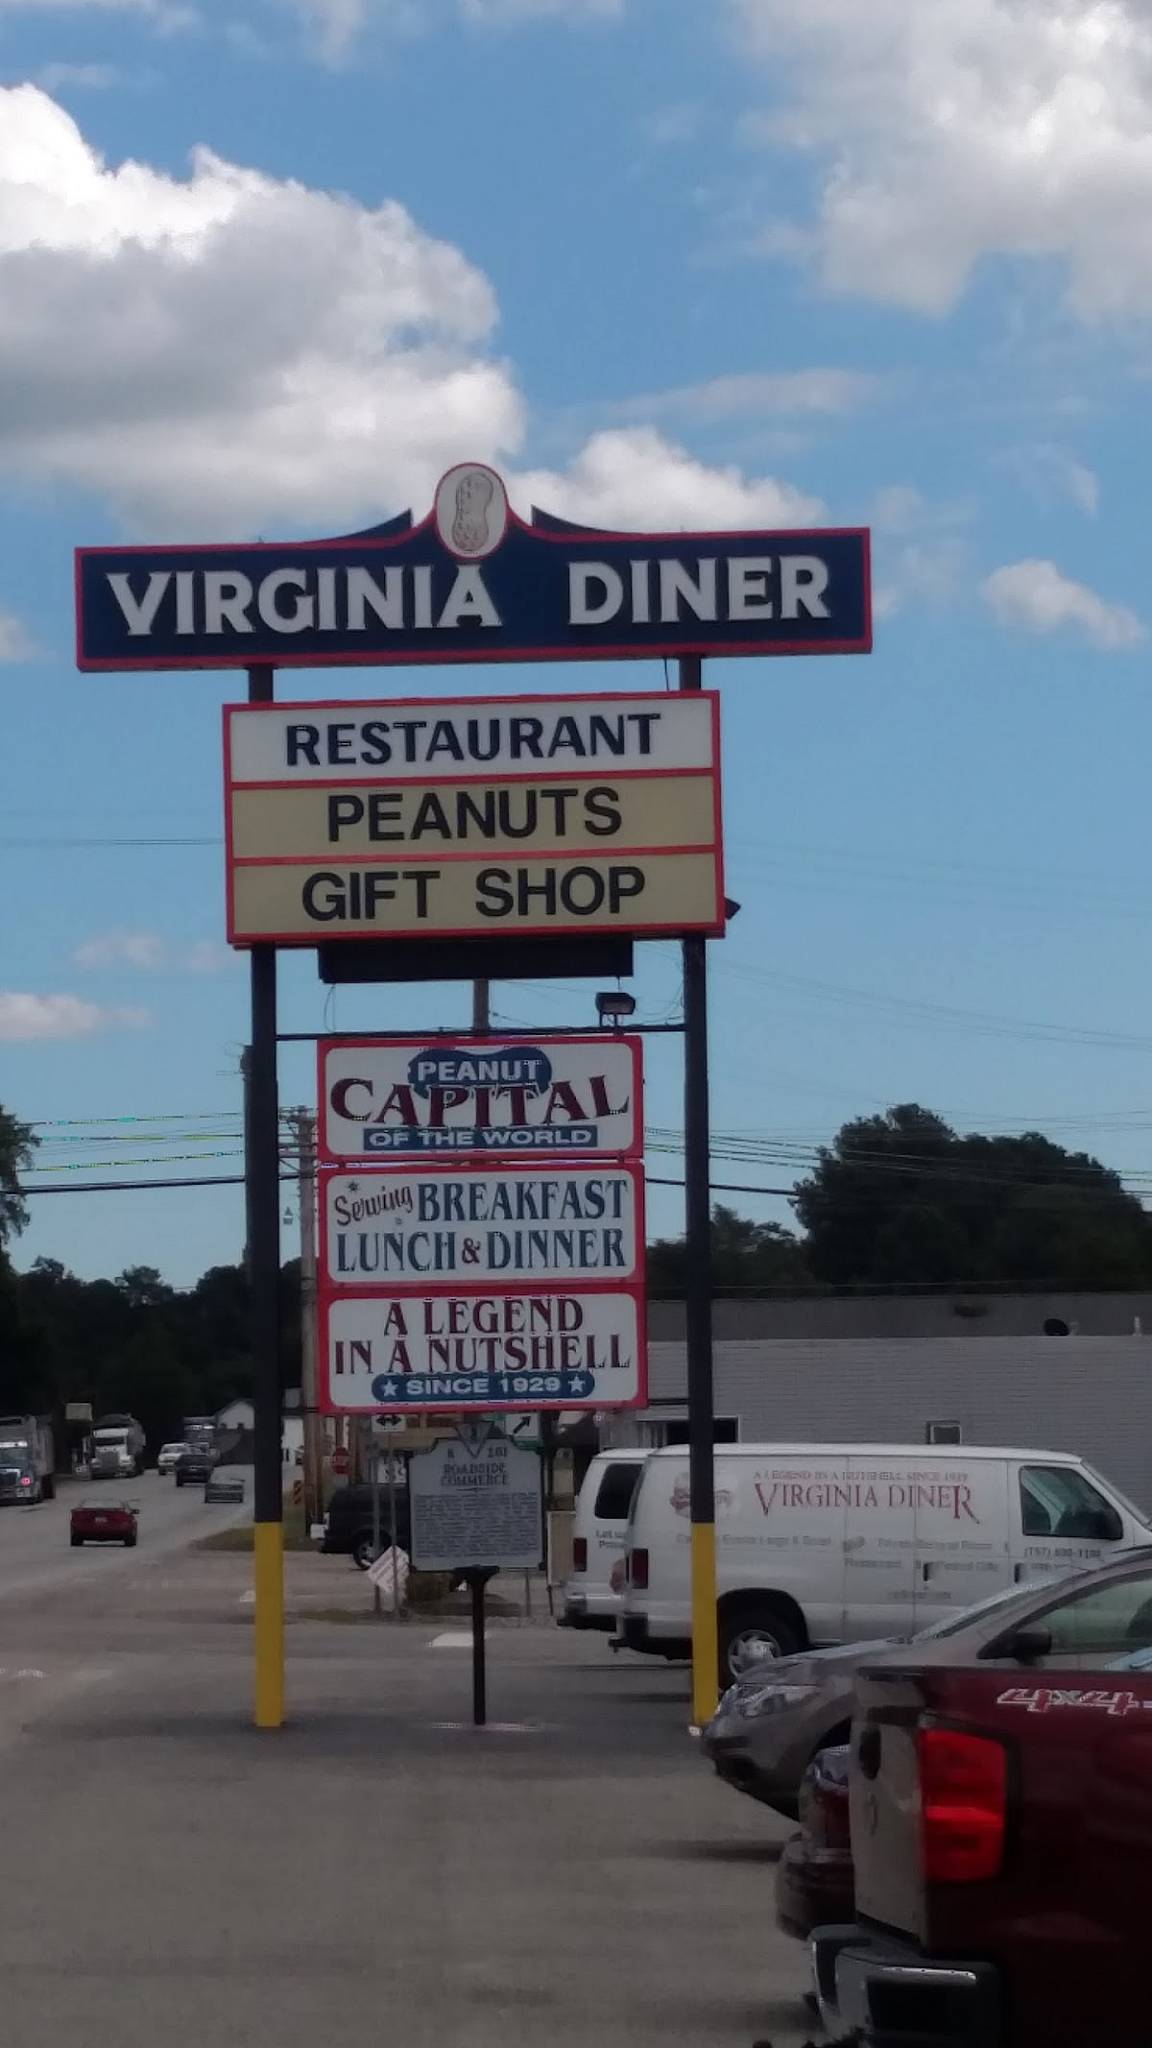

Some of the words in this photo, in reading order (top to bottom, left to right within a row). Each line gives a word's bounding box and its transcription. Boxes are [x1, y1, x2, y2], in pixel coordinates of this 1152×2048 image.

[105, 561, 503, 637] VIRGINIA
[568, 555, 831, 626] DINER
[286, 713, 661, 767] RESTAURANT
[328, 786, 622, 842] PEANUTS
[301, 870, 441, 922] GIFT
[475, 866, 645, 917] SHOP
[417, 1060, 541, 1082] PEANUT
[330, 1074, 630, 1128] CAPITAL
[369, 1131, 409, 1146] OF
[421, 1130, 474, 1146] THE
[483, 1129, 593, 1145] WORLD
[334, 1184, 413, 1226] Serving
[417, 1179, 628, 1222] BREAKFAST
[336, 1231, 456, 1272] LUNCH
[461, 1237, 481, 1264] &
[486, 1228, 627, 1270] DINNER
[383, 1301, 409, 1336] A
[423, 1298, 583, 1335] LEGEND
[335, 1340, 373, 1374] IN
[386, 1339, 413, 1374] A
[428, 1334, 631, 1372] NUTSHELL
[406, 1379, 490, 1395] SINCE
[499, 1377, 560, 1394] 1929
[754, 1482, 879, 1517] VIRGINIA
[888, 1484, 980, 1524] DINER
